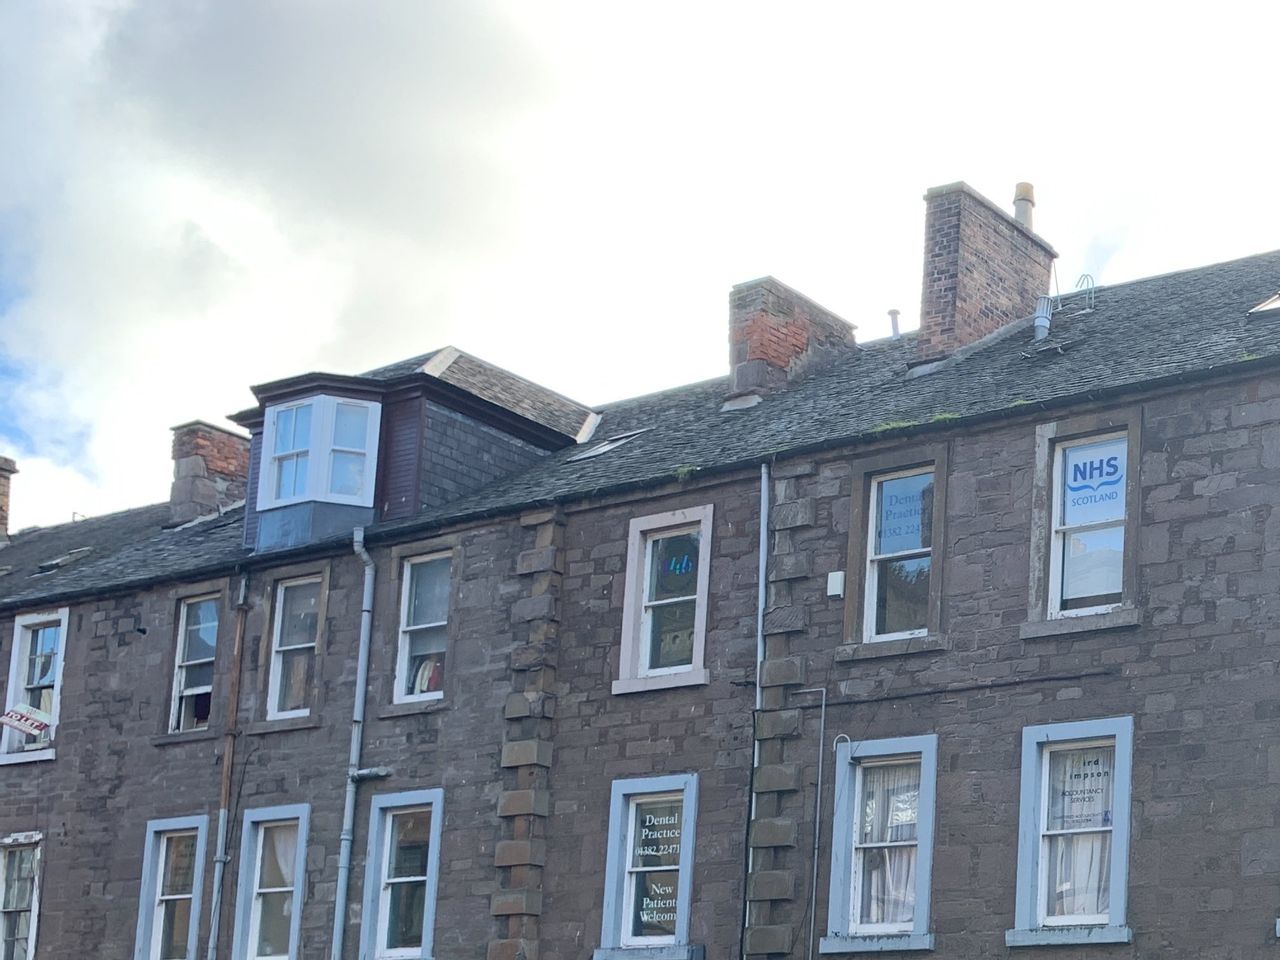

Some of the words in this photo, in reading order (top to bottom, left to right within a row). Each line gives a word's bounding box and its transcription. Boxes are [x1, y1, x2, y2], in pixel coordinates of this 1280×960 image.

[1073, 456, 1119, 482] NHS
[1071, 491, 1118, 507] SCOTLAND
[6, 711, 22, 722] TO
[645, 812, 678, 826] Dental
[642, 828, 681, 840] Practice
[635, 845, 657, 856] 01382
[658, 844, 680, 855] 22471
[651, 883, 673, 895] New
[643, 896, 677, 909] Patient
[640, 910, 677, 922] Welcom
